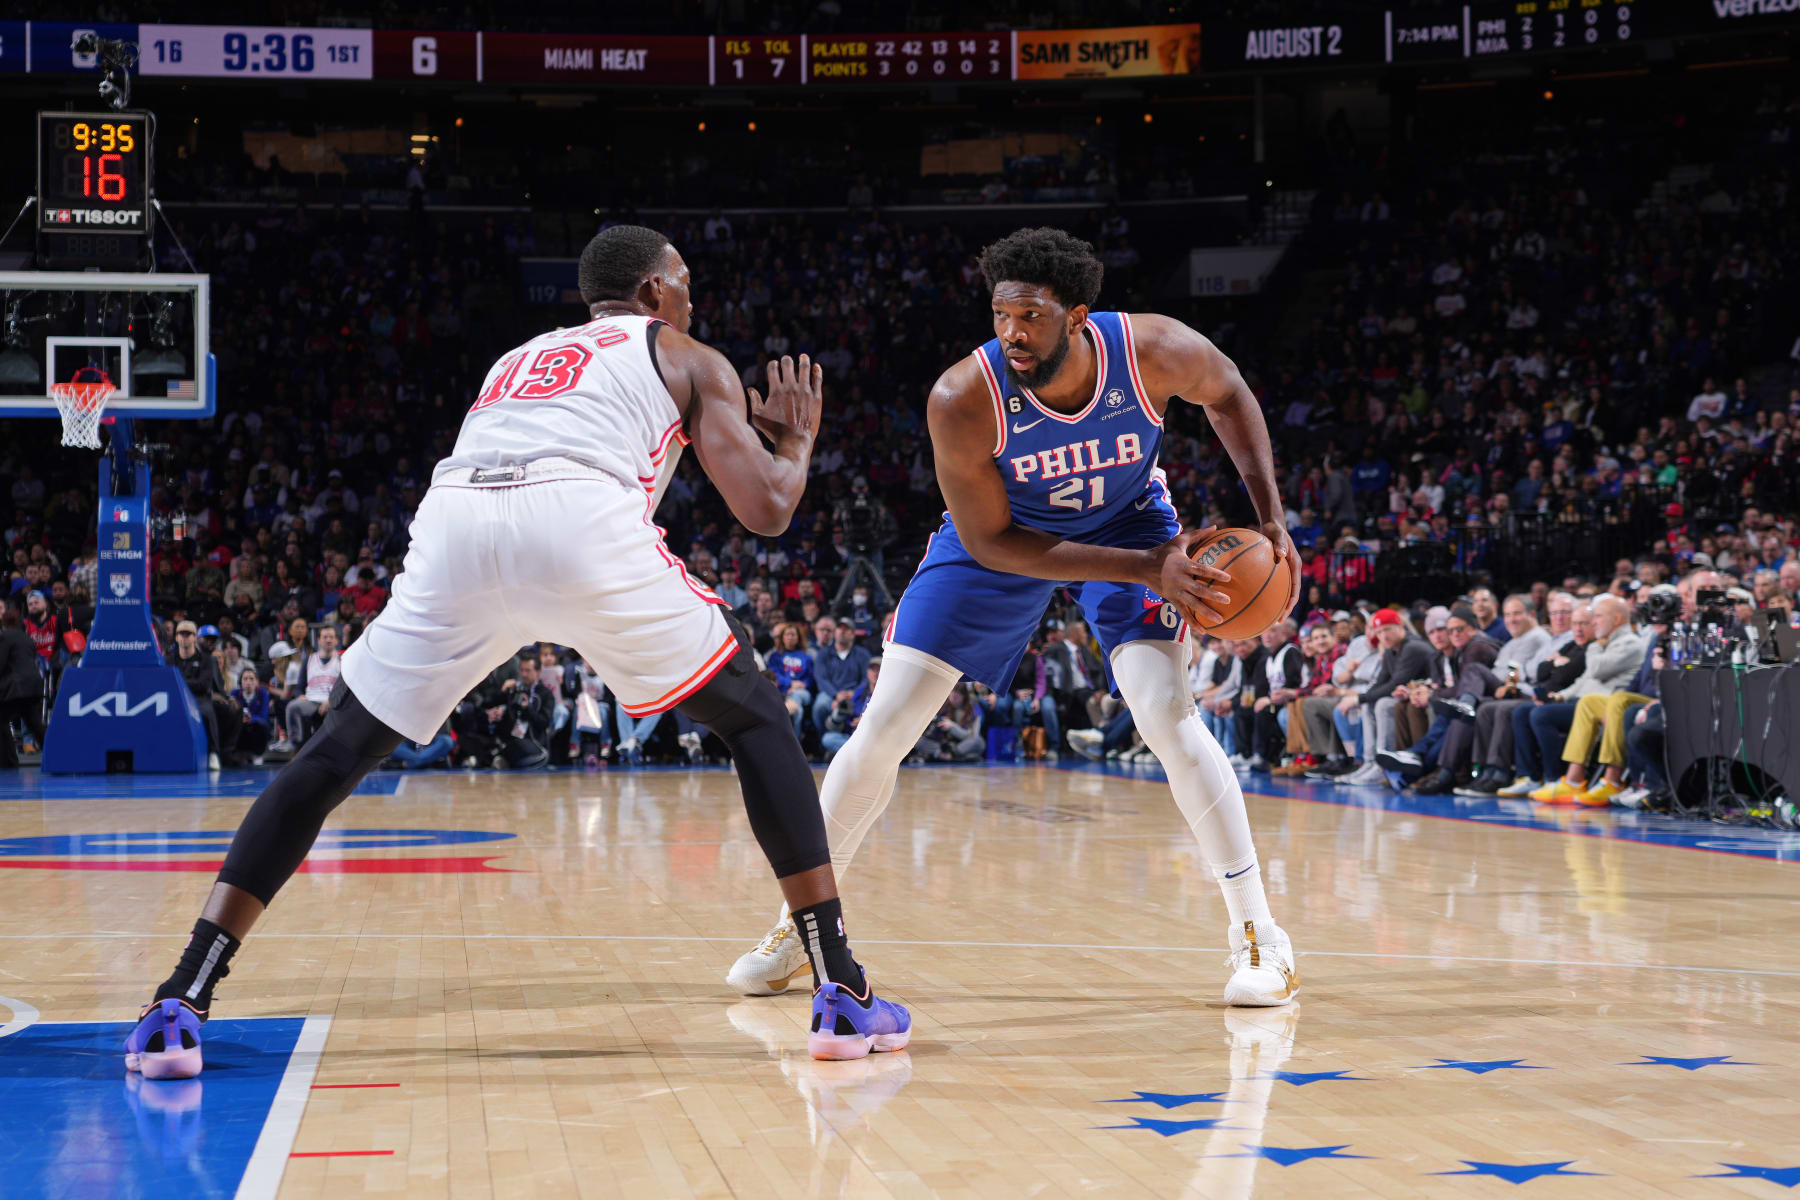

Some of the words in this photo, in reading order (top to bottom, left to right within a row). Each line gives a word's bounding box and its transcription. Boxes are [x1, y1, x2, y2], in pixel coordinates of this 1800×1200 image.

[1713, 0, 1800, 18] verizo
[1477, 19, 1506, 35] PHI
[1521, 17, 1533, 32] 2
[1555, 13, 1565, 28] 1
[1585, 9, 1598, 25] 0
[1617, 6, 1631, 22] 0
[1245, 27, 1324, 60] AUGUST
[1327, 25, 1343, 55] 2
[1431, 25, 1459, 41] PM
[1476, 37, 1509, 53] MIA
[1522, 35, 1533, 49] 3
[1553, 32, 1565, 47] 2
[1585, 27, 1598, 43] 0
[1618, 24, 1631, 40] 0
[153, 40, 182, 63] 16
[223, 33, 314, 71] 9:36
[327, 45, 360, 63] 1ST
[412, 37, 437, 75] 6
[725, 40, 751, 56] FLS
[763, 40, 792, 55] TOL
[812, 42, 868, 57] PLAYER
[875, 41, 895, 56] 22
[901, 41, 923, 56] 42
[931, 41, 949, 55] 13
[958, 40, 977, 54] 14
[1021, 43, 1071, 64] SAM
[544, 48, 594, 70] MIAMI
[601, 48, 649, 71] HEAT
[731, 58, 744, 79] 1
[770, 58, 786, 79] 7
[813, 62, 868, 77] POINTS
[880, 61, 890, 75] 3
[905, 60, 919, 75] 0
[932, 60, 946, 75] 0
[960, 59, 973, 75] 0
[989, 60, 1000, 74] 3
[73, 123, 134, 152] 9:35
[84, 153, 126, 201] 16
[72, 208, 141, 224] TISSOT
[528, 284, 558, 302] 119
[469, 343, 594, 413] 13
[1009, 396, 1022, 413] 6
[1101, 404, 1137, 421] crypto.com
[1010, 432, 1144, 483] PHILA
[1049, 475, 1106, 513] 21
[100, 550, 142, 560] BETMGM
[1143, 597, 1178, 629] 76
[89, 639, 149, 651] ticketmaster
